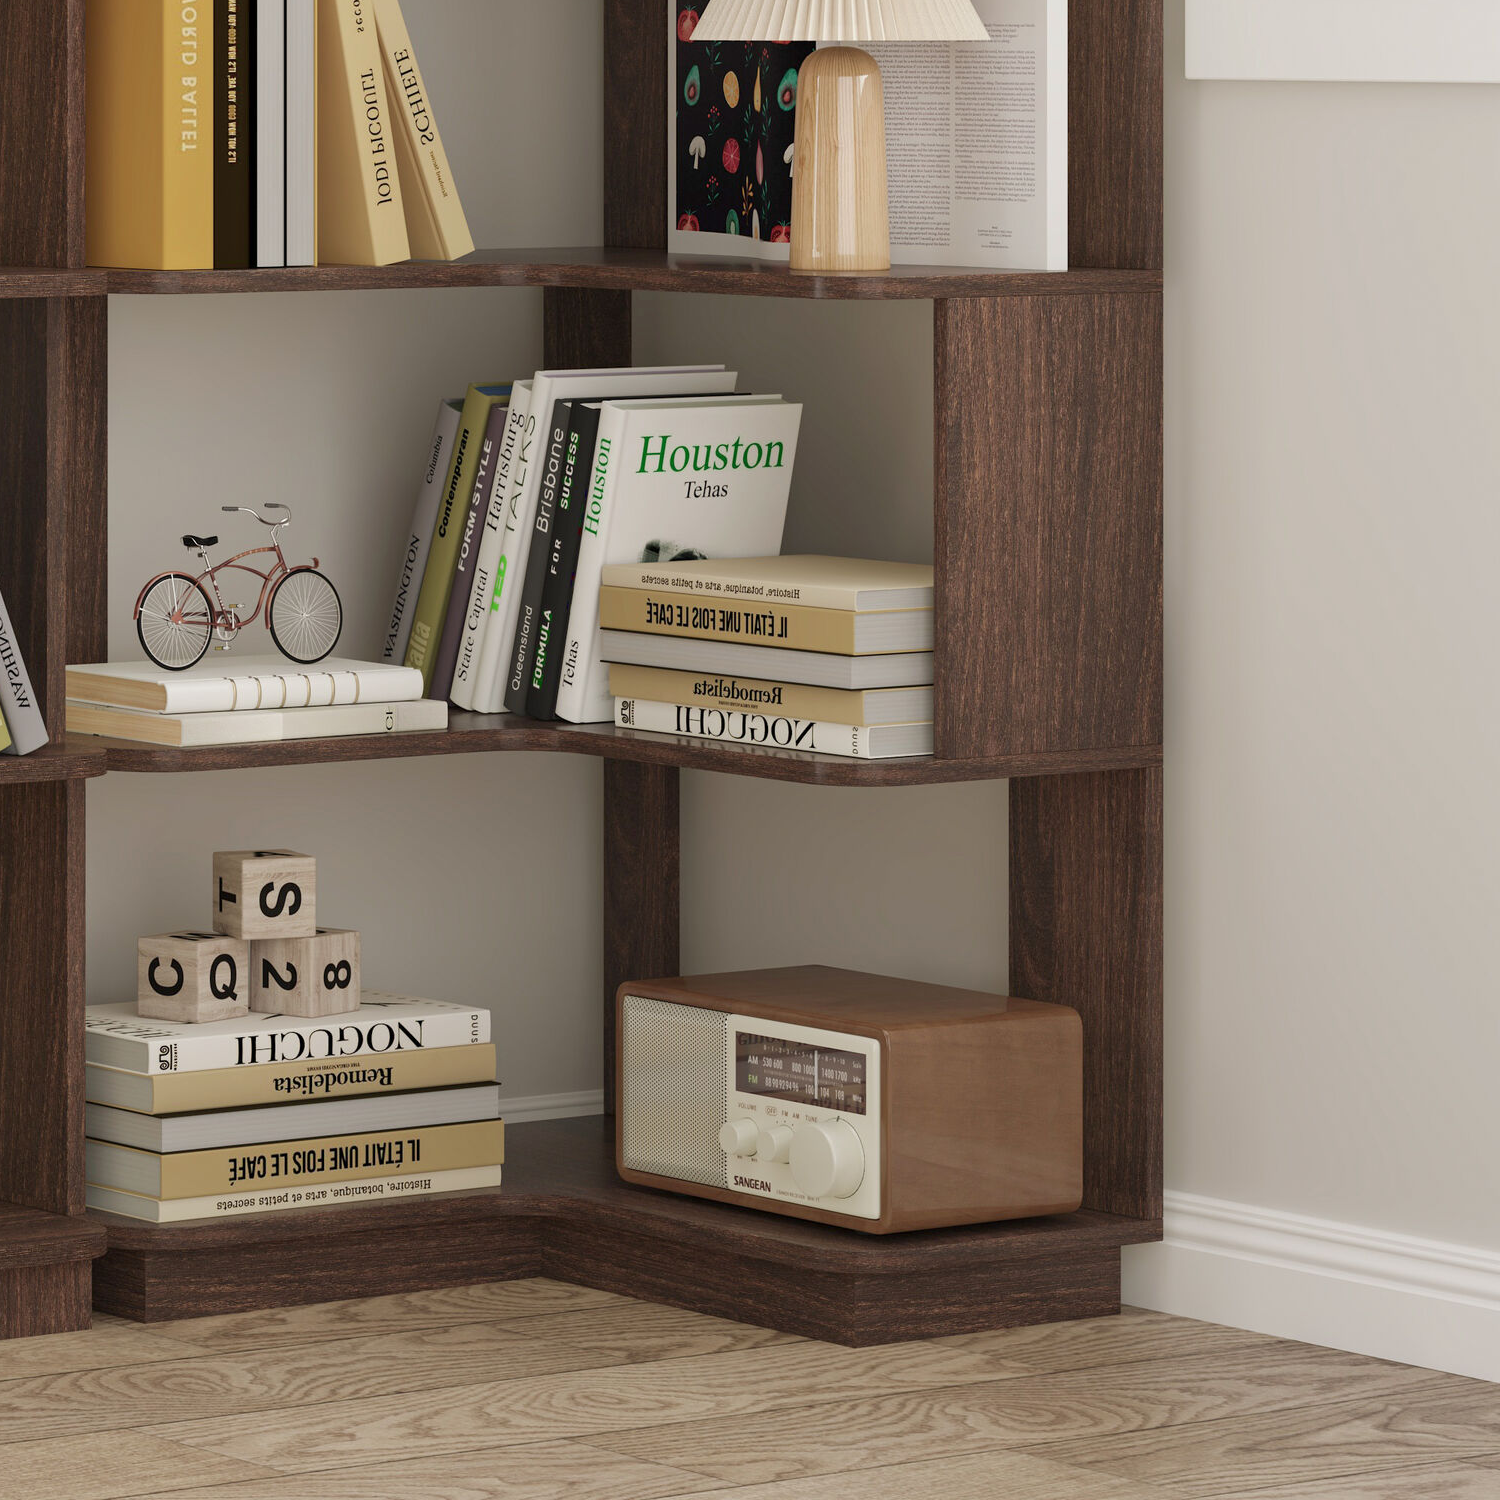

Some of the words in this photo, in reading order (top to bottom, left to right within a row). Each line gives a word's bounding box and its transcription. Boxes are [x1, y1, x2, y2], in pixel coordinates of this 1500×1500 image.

[636, 435, 784, 474] Houston
[684, 480, 729, 499] Tehas
[384, 533, 420, 658] WASHINGTON
[426, 435, 443, 484] Columbia
[458, 637, 475, 682] State
[468, 568, 489, 631] Capital
[486, 409, 524, 532] Harrisburg
[511, 605, 533, 691] Queensland
[536, 428, 563, 534] Brisbane
[562, 639, 579, 688] Tehas
[584, 438, 612, 537] Houston
[219, 877, 236, 912] T
[259, 881, 301, 918] S
[148, 957, 184, 996] C
[210, 954, 238, 1001] Q
[235, 1019, 425, 1066] NOGUCHI
[470, 1014, 479, 1044] DUUS
[273, 1066, 393, 1094] Remodelista
[738, 1102, 757, 1111] VOLUME
[805, 1115, 818, 1123] TUNE
[734, 1175, 771, 1193] SANGEAN
